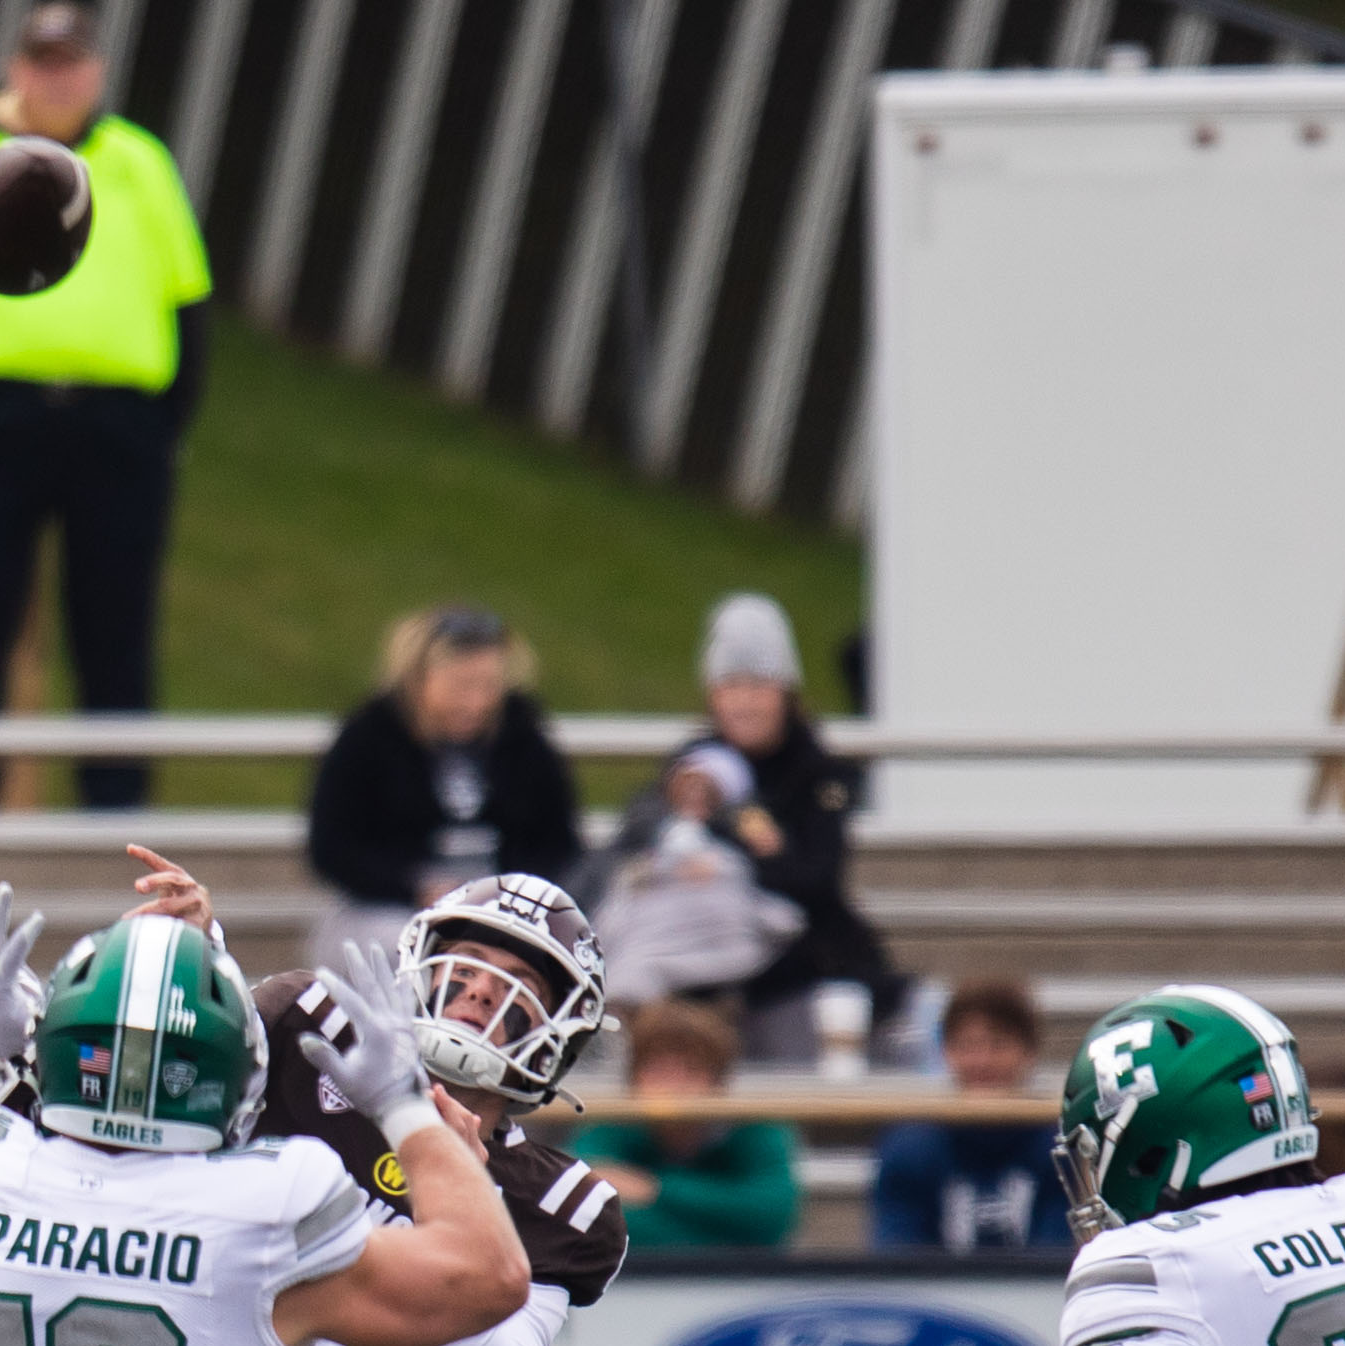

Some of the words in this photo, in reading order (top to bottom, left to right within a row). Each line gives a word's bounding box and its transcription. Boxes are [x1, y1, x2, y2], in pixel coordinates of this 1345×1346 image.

[1088, 1019, 1159, 1121] E
[81, 1073, 102, 1097] FR
[92, 1119, 164, 1146] EAGLES
